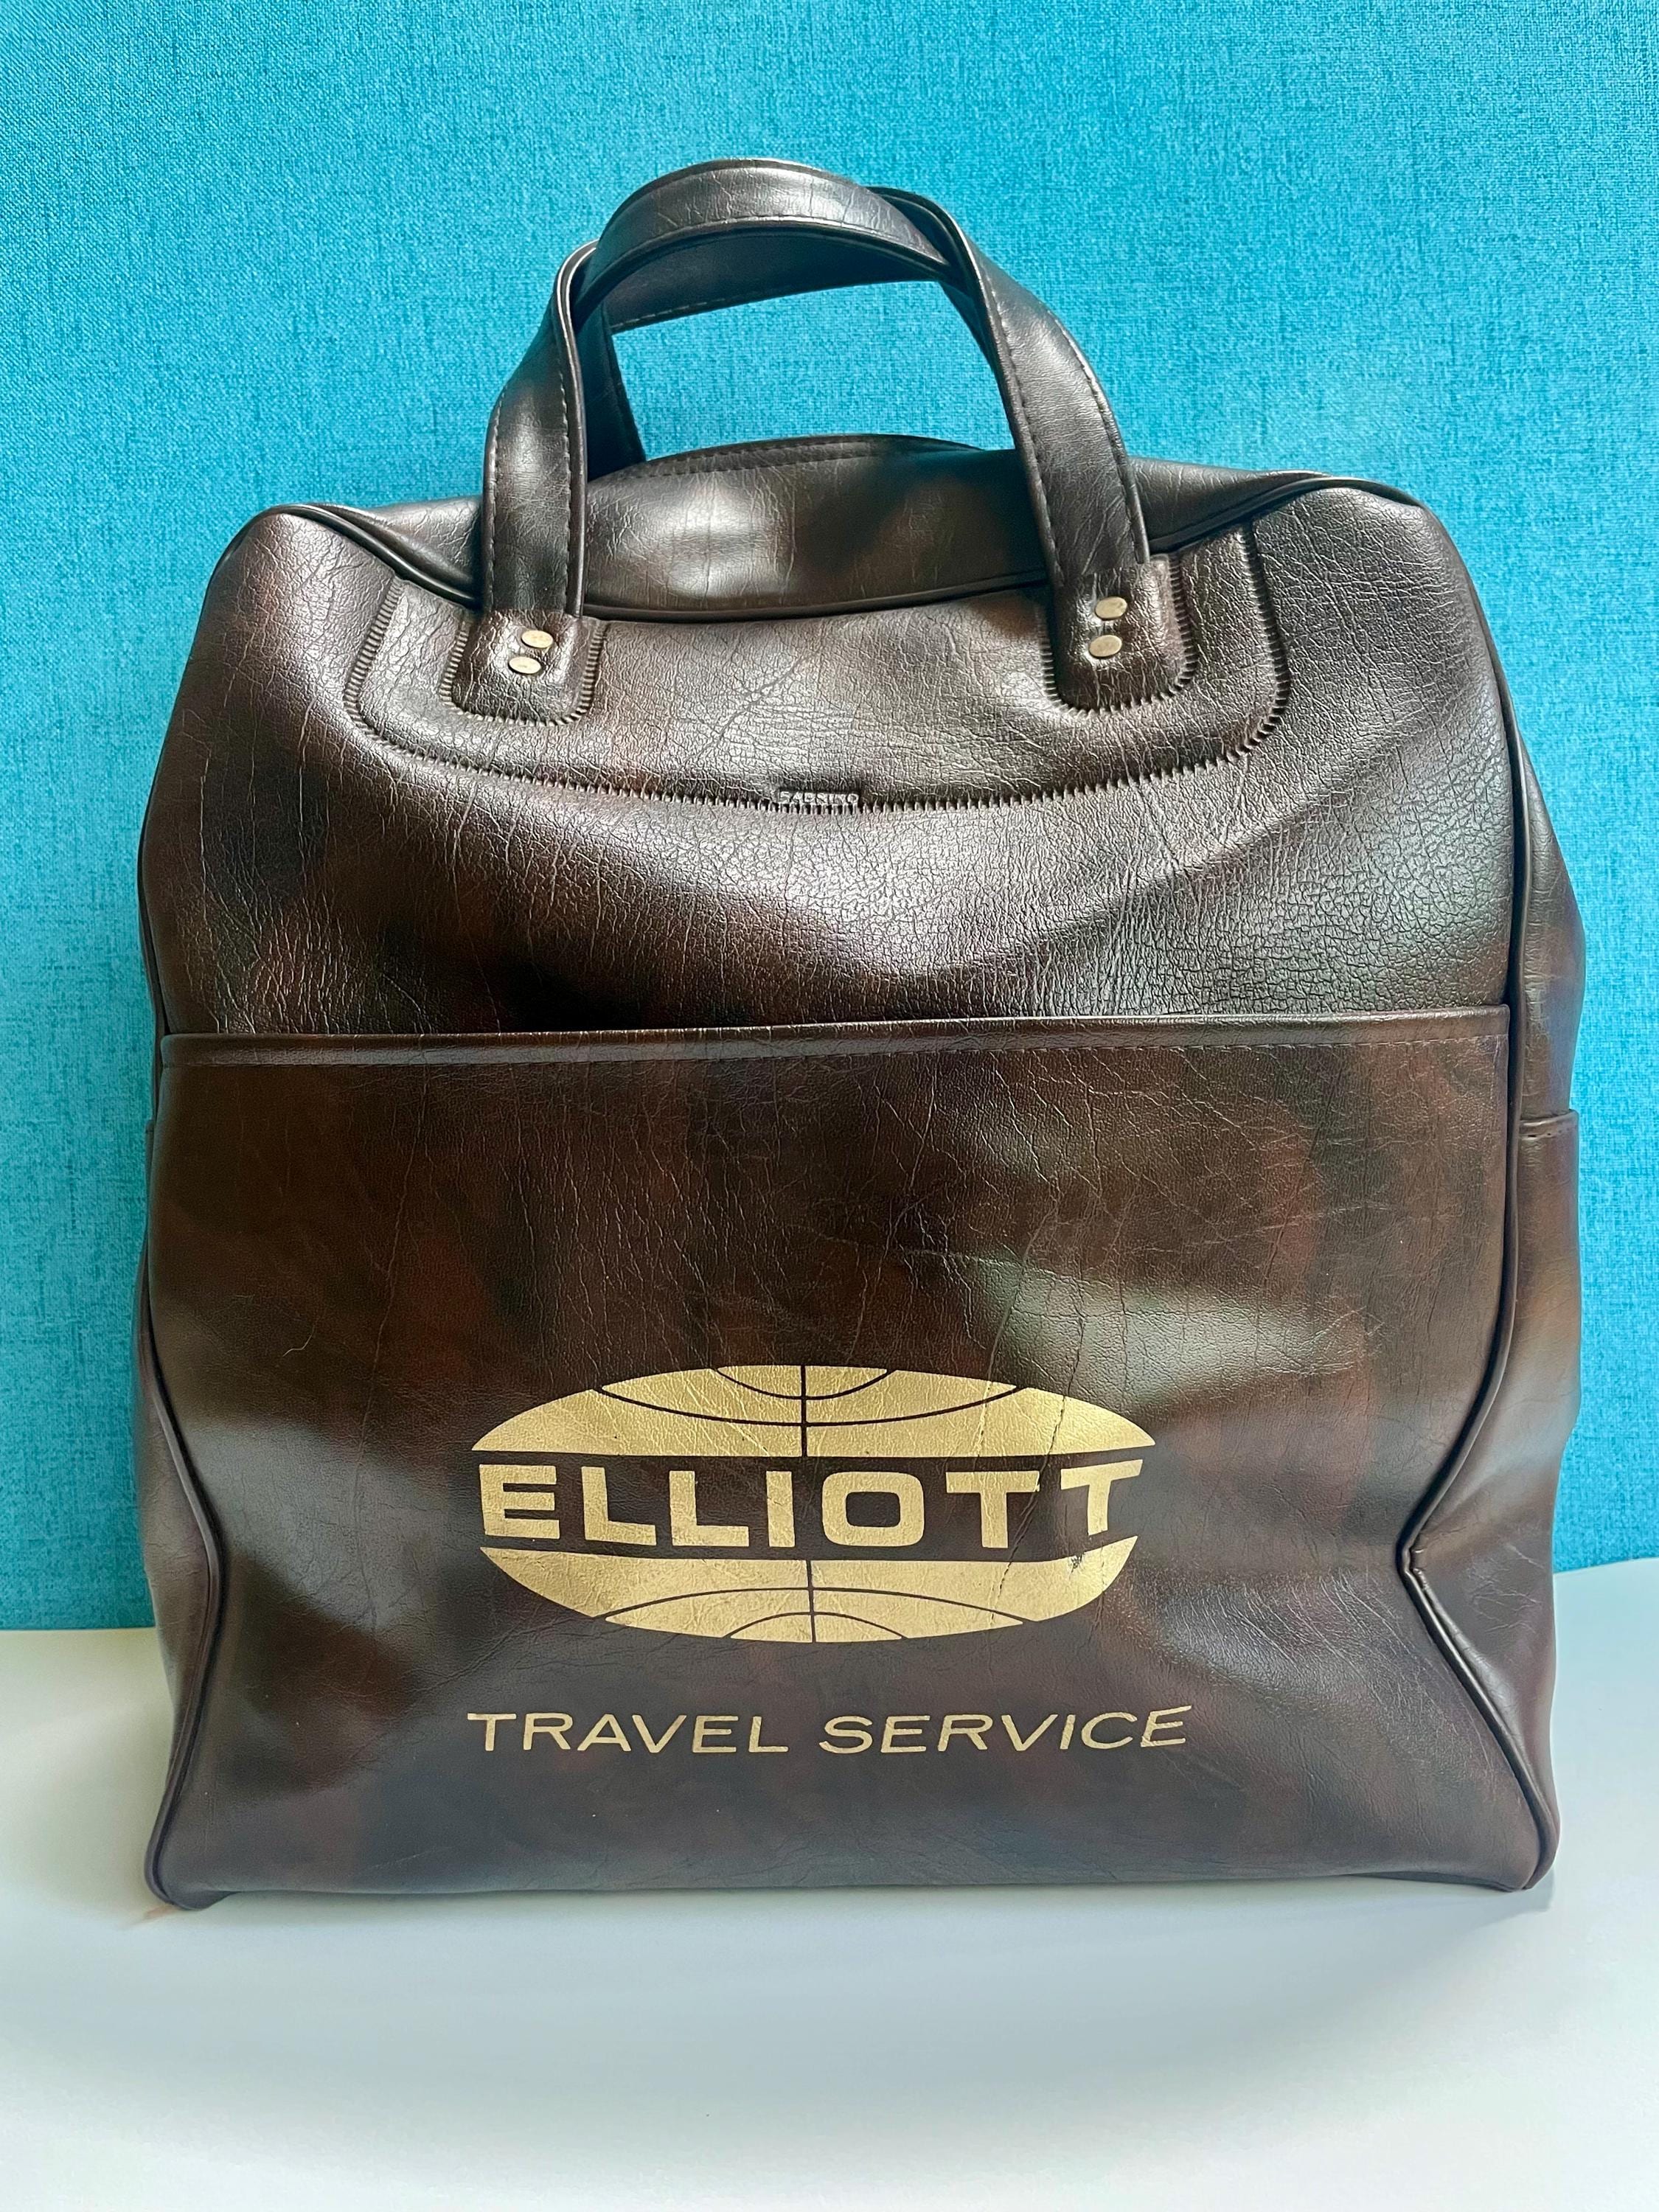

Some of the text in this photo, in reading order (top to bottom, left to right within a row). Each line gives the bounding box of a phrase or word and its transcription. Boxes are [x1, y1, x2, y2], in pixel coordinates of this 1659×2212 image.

[479, 1458, 1144, 1549] ELLIOTT
[467, 1705, 1192, 1754] TRAVEL SERVICE
